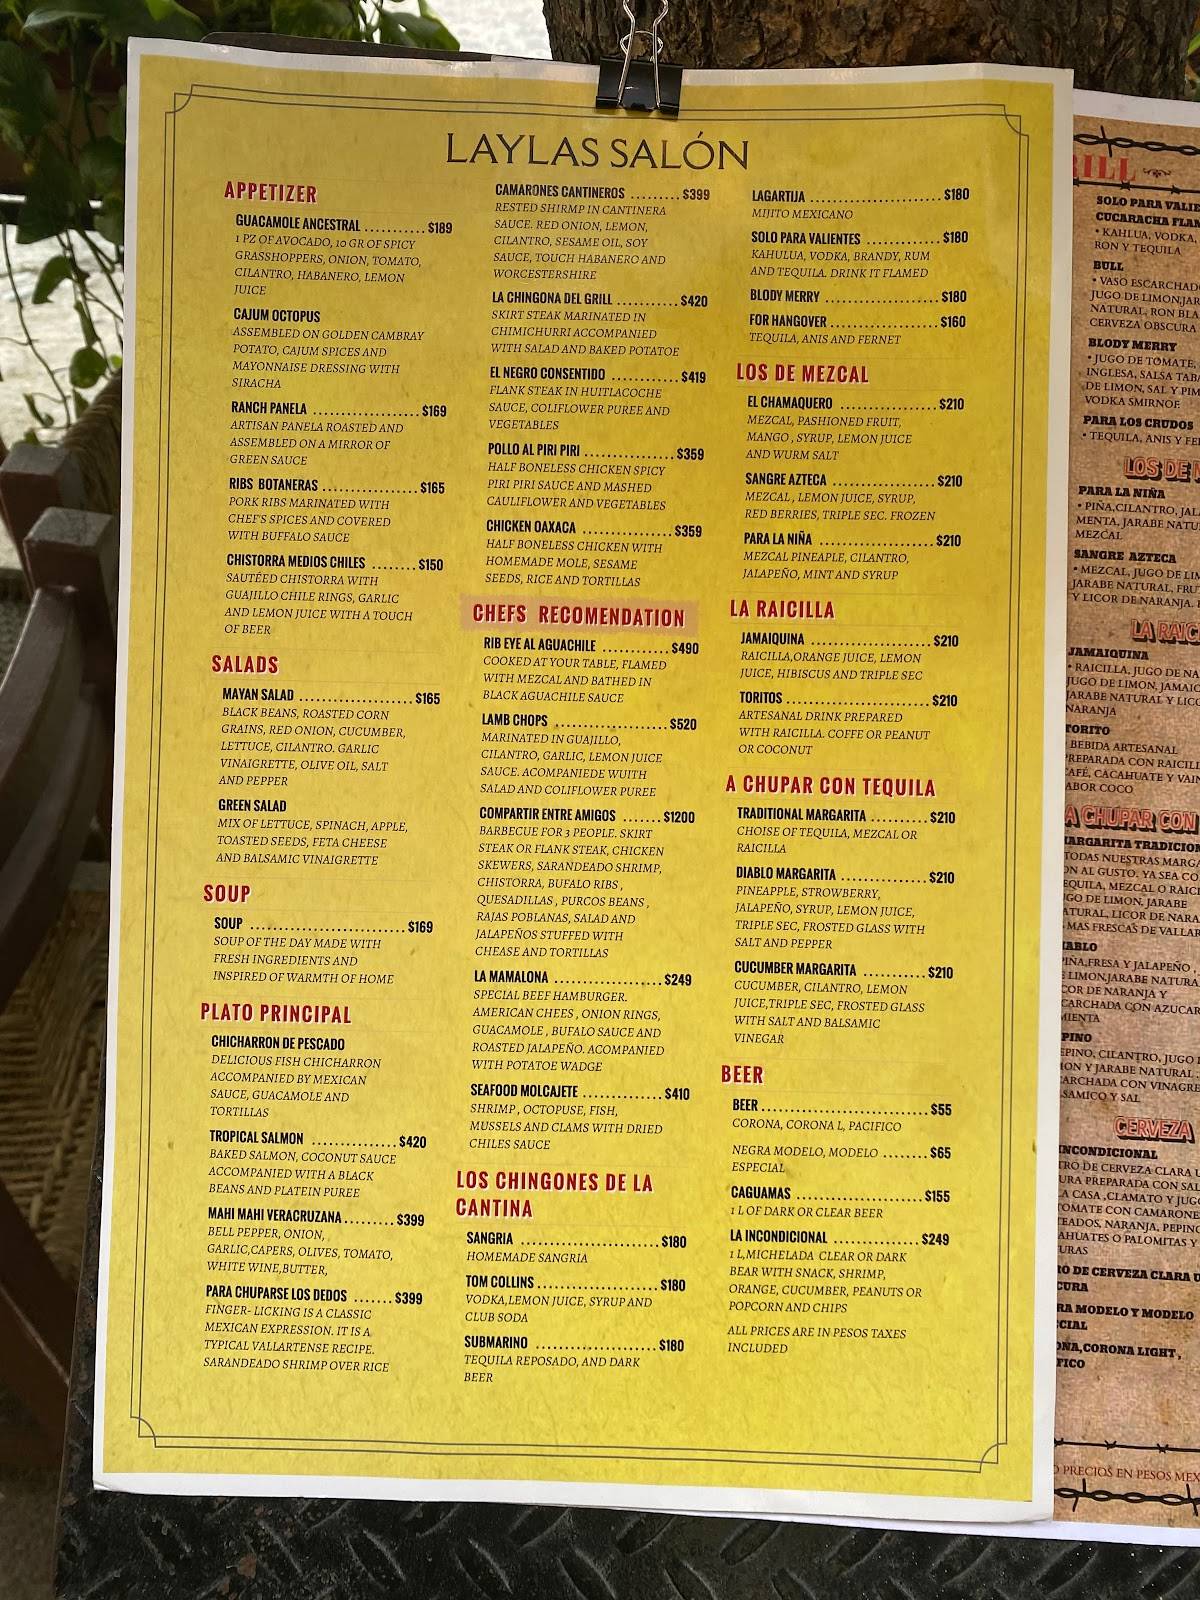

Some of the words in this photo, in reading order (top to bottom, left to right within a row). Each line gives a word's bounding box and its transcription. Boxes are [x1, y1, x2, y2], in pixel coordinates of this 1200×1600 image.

[446, 132, 600, 167] LAYLAS
[610, 130, 748, 170] SALÓN
[224, 180, 316, 203] APPETIZER
[495, 183, 558, 197] CAMARONES
[561, 185, 624, 199] CANTINEROS
[682, 188, 710, 200] $399
[752, 189, 805, 202] LAGARTIJA
[944, 187, 969, 200] $180
[791, 209, 853, 220] MEXICANO
[235, 213, 300, 229] GUACAMOLE
[302, 217, 361, 232] ANCESTRAL
[428, 221, 452, 234] $189
[751, 230, 778, 243] SOLO
[780, 231, 806, 244] PARA
[808, 232, 861, 245] VALIENTES
[943, 230, 968, 244] $180
[809, 251, 849, 263] VODKA,
[853, 251, 900, 262] BRANDY,
[904, 250, 929, 261] RUM
[1094, 240, 1119, 251] RON
[1121, 241, 1130, 251] Y
[1133, 243, 1182, 256] TEQUILA
[235, 250, 325, 265] GRASSHOPPERS,
[328, 254, 369, 266] ONION,
[372, 255, 421, 268] TOMATO,
[1093, 260, 1124, 271] BULL
[492, 291, 504, 303] LA
[506, 291, 561, 304] CHINGONA
[563, 292, 582, 304] DEL
[584, 292, 612, 305] GRILL
[680, 294, 707, 307] $420
[234, 307, 269, 321] CAJUM
[272, 309, 320, 323] OCTOPUS
[491, 326, 571, 337] CHIMICHURRI
[572, 327, 657, 339] ACCOMPANIED
[1089, 317, 1141, 329] CERVEZA
[1143, 320, 1196, 333] OBSCURA
[1088, 337, 1130, 349] BLODY
[1131, 339, 1177, 352] MERRY
[736, 362, 768, 381] LOS
[774, 363, 795, 381] DE
[802, 364, 868, 383] MEZCAL
[747, 395, 758, 407] EL
[760, 395, 833, 410] CHAMAQUERO
[939, 397, 964, 410] $210
[1083, 415, 1117, 427] PARA
[1119, 416, 1142, 427] LOS
[1144, 418, 1193, 430] CRUDOS
[488, 442, 519, 455] POLLO
[522, 443, 534, 455] AL
[537, 443, 556, 456] PIRI
[560, 444, 579, 457] PIRI
[676, 447, 704, 460] $359
[1123, 455, 1162, 480] LOS
[1163, 458, 1192, 483] DE
[1078, 485, 1113, 496] PARA
[1114, 487, 1131, 497] LA
[1132, 486, 1166, 499] NIÑA
[744, 532, 770, 544] PARA
[772, 532, 785, 544] LA
[787, 530, 812, 545] NIÑA
[936, 534, 961, 546] $210
[227, 553, 285, 567] CHISTORRA
[288, 554, 327, 568] MEDIOS
[330, 555, 365, 569] CHILES
[418, 558, 443, 571] $150
[279, 574, 344, 585] CHISTORRA
[347, 575, 379, 586] WITH
[472, 603, 526, 623] CHEFS
[538, 604, 684, 627] RECOMENDATION
[730, 599, 749, 617] LA
[756, 599, 834, 618] RAICILLA
[740, 632, 804, 646] JAMAIQUINA
[933, 634, 958, 647] $210
[1068, 646, 1149, 660] JAMAIQUINA
[212, 654, 277, 674] SALADS
[222, 687, 258, 700] MAYAN
[261, 688, 293, 701] SALAD
[415, 692, 440, 704] $165
[738, 709, 802, 721] ARTESANAL
[805, 711, 842, 722] DRINK
[843, 712, 903, 722] PREPARED
[725, 774, 735, 792] A
[743, 774, 812, 794] CHUPAR
[819, 776, 854, 795] CON
[862, 777, 935, 797] TEQUILA
[479, 806, 539, 820] COMPARTIR
[542, 807, 572, 821] ENTRE
[574, 808, 615, 822] AMIGOS
[663, 810, 695, 823] $1200
[737, 806, 803, 820] TRADITIONAL
[805, 808, 866, 822] MARGARITA
[930, 811, 955, 824] $210
[1080, 804, 1157, 832] CHUPAR
[1158, 809, 1199, 834] CON
[217, 835, 268, 846] TOASTED
[270, 836, 309, 848] SEEDS,
[312, 837, 339, 847] FETA
[341, 837, 387, 848] CHEESE
[477, 859, 534, 872] SKEWERS,
[536, 861, 613, 872] SARANDEADO
[615, 862, 661, 875] SHRIMP,
[203, 884, 250, 903] SOUP
[201, 1002, 252, 1021] PLATO
[260, 1004, 351, 1024] PRINCIPAL
[211, 1034, 279, 1049] CHICHARRON
[282, 1036, 295, 1049] DE
[297, 1037, 344, 1051] PESCADO
[721, 1064, 762, 1084] BEER
[732, 1098, 758, 1111] BEER
[930, 1103, 951, 1116] $55
[732, 1117, 782, 1130] CORONA,
[786, 1119, 834, 1130] CORONA
[848, 1120, 901, 1132] PACIFICO
[1115, 1115, 1196, 1144] CERVEZA
[457, 1170, 488, 1189] LOS
[495, 1171, 598, 1191] CHINGONES
[605, 1173, 626, 1191] DE
[633, 1174, 652, 1192] LA
[456, 1197, 532, 1217] CANTINA
[208, 1206, 235, 1220] MAHI
[237, 1207, 264, 1221] MAHI
[266, 1208, 342, 1224] VERACRUZANA
[396, 1213, 424, 1226] $399
[466, 1231, 513, 1245] SANGRIA
[661, 1235, 686, 1248] $180
[730, 1228, 742, 1242] LA
[745, 1229, 828, 1243] INCONDICIONAL
[921, 1232, 949, 1246] $249
[726, 1325, 748, 1335] ALL
[750, 1325, 790, 1336] PRICES
[791, 1326, 815, 1337] ARE
[817, 1327, 831, 1337] IN
[833, 1327, 868, 1338] PESOS
[871, 1328, 907, 1339] TAXES
[728, 1342, 788, 1353] INCLUDED
[203, 1357, 280, 1369] SARANDEADO
[282, 1359, 327, 1370] SHRIMP
[329, 1360, 359, 1371] OVER
[362, 1361, 389, 1372] RICE
[464, 1354, 512, 1367] TEQUILA
[516, 1355, 578, 1368] REPOSADO,
[581, 1356, 606, 1367] AND
[609, 1357, 640, 1367] DARK
[1063, 1465, 1112, 1478] PRECIOS
[1116, 1467, 1134, 1478] EN
[1136, 1469, 1172, 1480] PESOS
